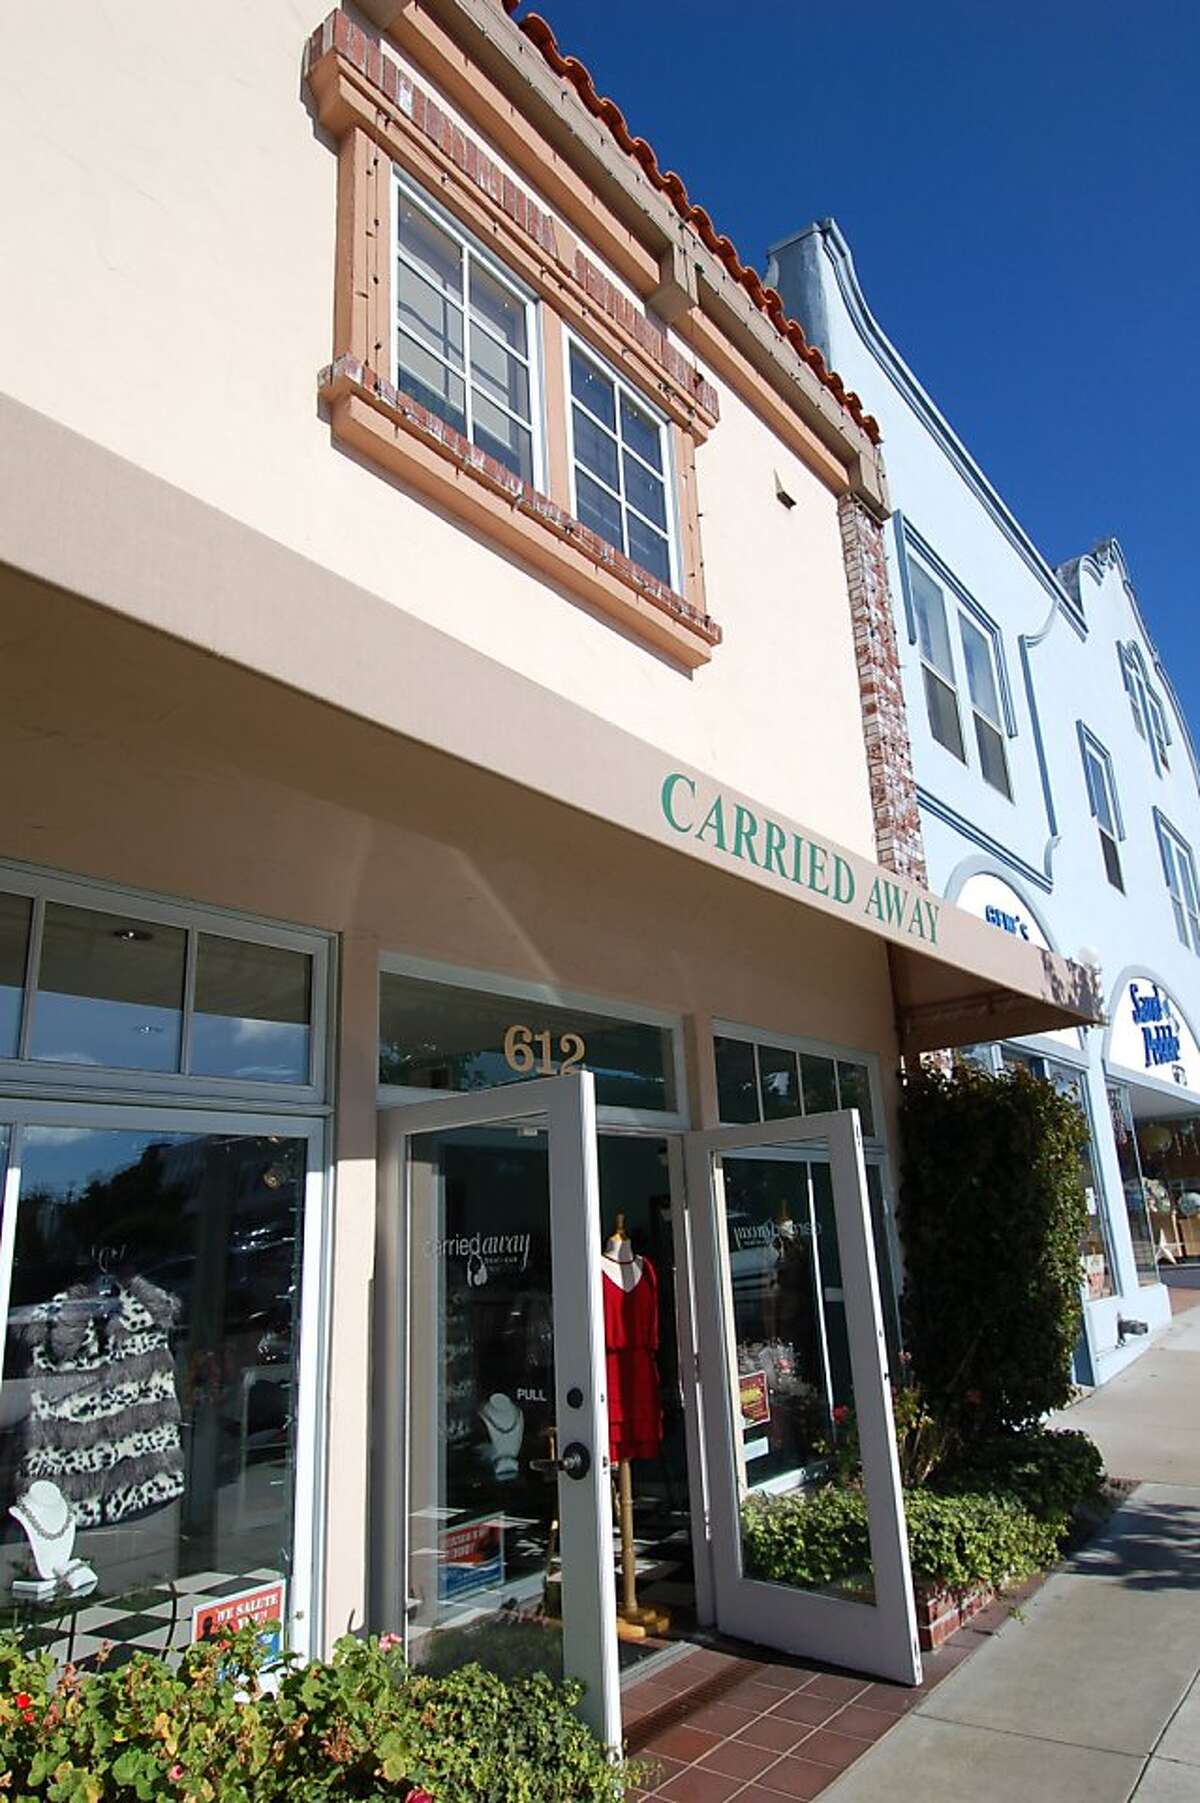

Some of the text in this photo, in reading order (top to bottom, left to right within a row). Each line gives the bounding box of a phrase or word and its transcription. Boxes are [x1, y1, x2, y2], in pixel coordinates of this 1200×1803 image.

[661, 773, 940, 944] CARRIED AWAY
[504, 1024, 585, 1077] 612
[482, 1234, 530, 1272] away
[516, 1387, 547, 1402] PULL
[216, 1593, 278, 1624] WE SALUTE
